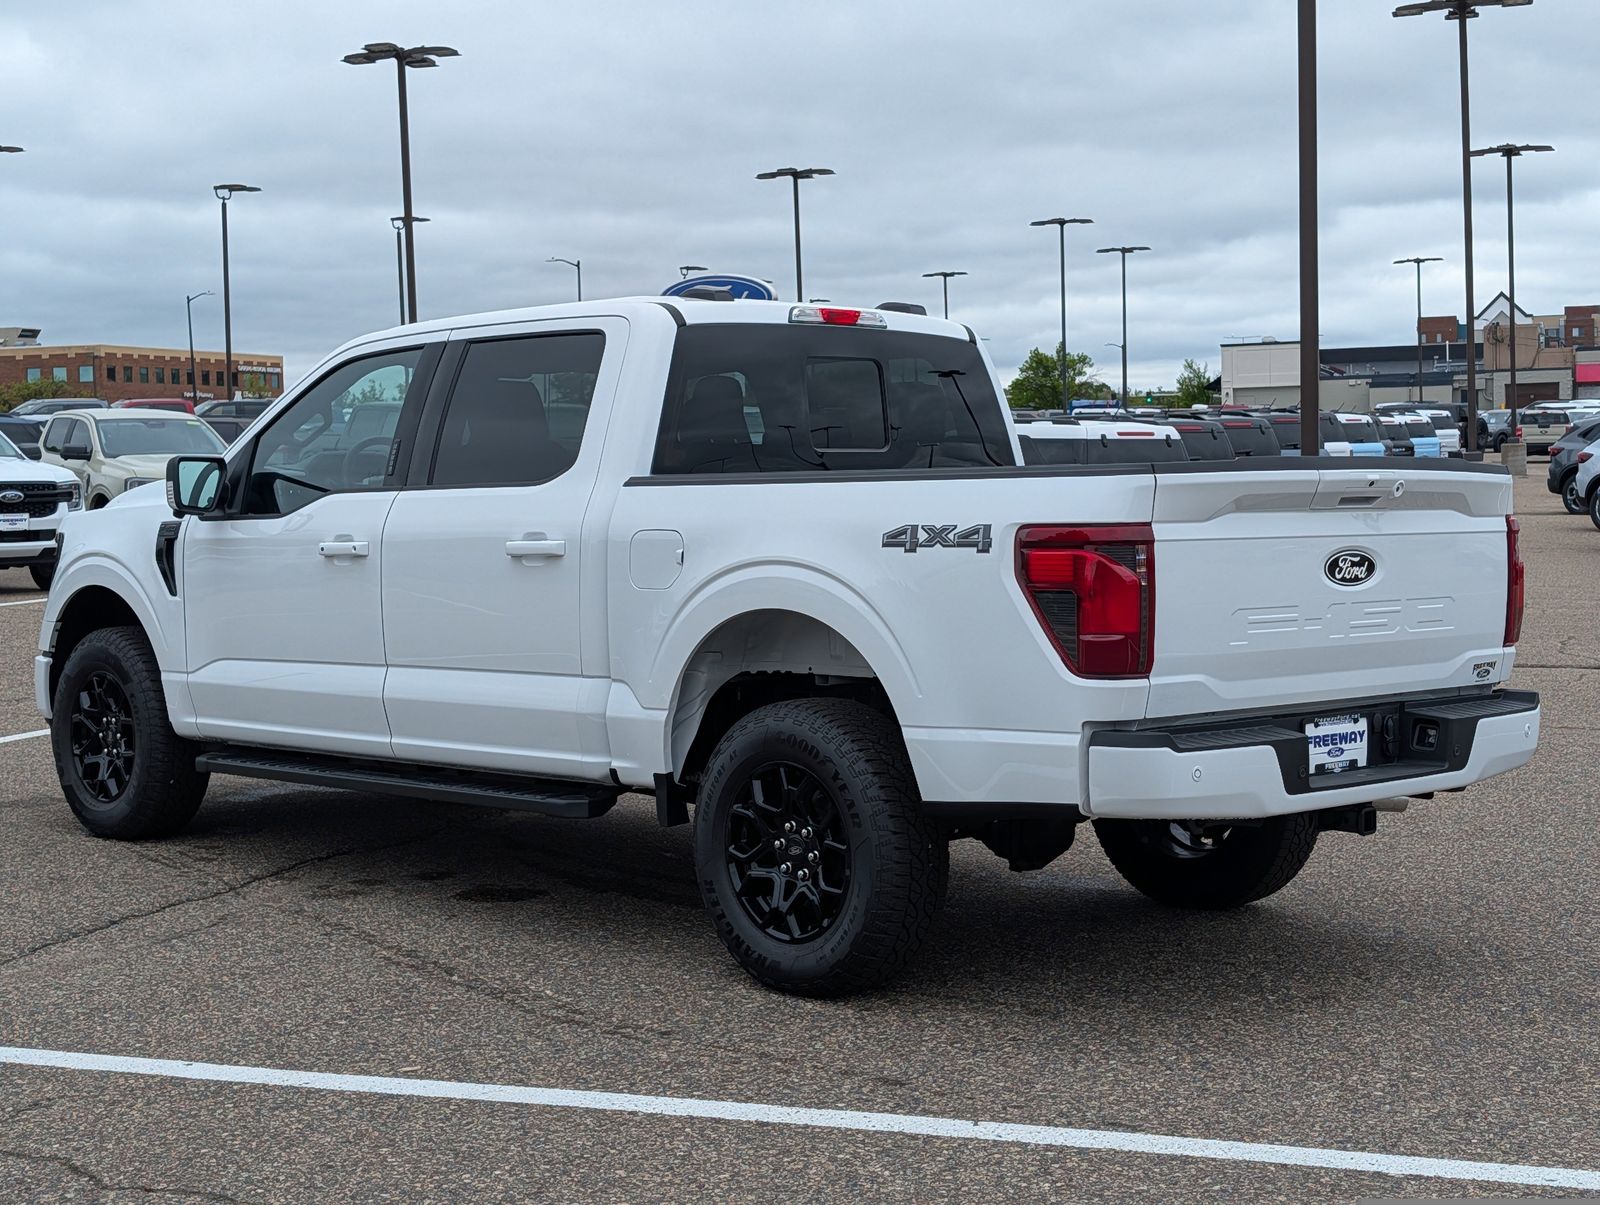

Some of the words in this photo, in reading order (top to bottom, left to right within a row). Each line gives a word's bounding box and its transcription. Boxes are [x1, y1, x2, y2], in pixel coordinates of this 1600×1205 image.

[1335, 556, 1368, 580] Ford
[1229, 596, 1456, 646] F-150
[1308, 730, 1366, 749] FREEWAY
[1329, 748, 1343, 757] Ford
[1325, 761, 1350, 770] FREEWAY
